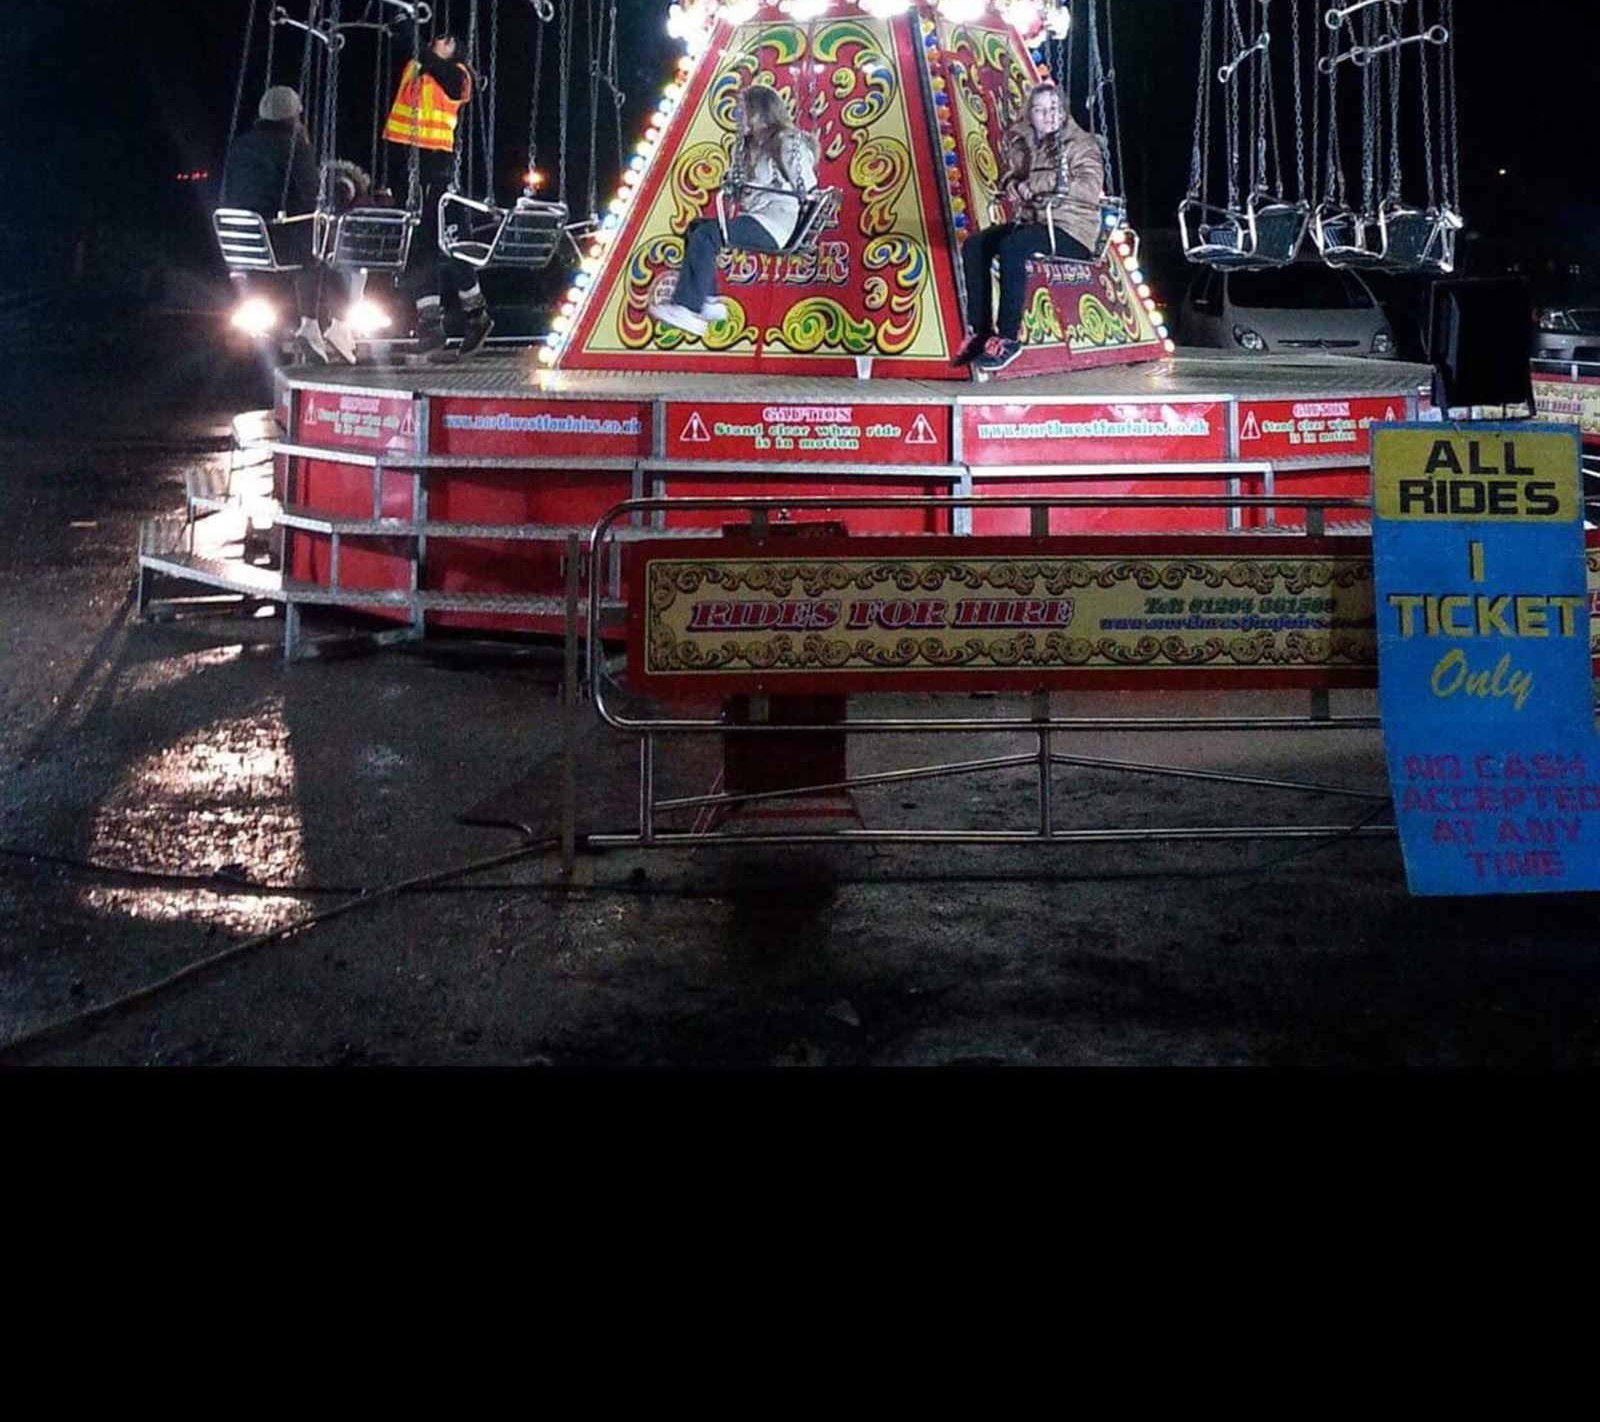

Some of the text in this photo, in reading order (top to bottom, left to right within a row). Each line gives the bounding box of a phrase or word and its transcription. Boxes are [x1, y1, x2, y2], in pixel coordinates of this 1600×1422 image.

[762, 407, 853, 423] CAUTION
[714, 423, 901, 438] Stand clear when ride
[755, 437, 860, 450] is in motion
[1424, 440, 1535, 476] ALL
[1399, 479, 1560, 516] RIDES
[688, 598, 1073, 631] RIDES FOR HIRE
[1386, 593, 1585, 638] TICKET
[1430, 649, 1533, 711] Only
[1405, 752, 1587, 781] NO CASH
[1403, 786, 1600, 814] ACCEPTED
[1432, 817, 1582, 846] AT ANY
[1467, 849, 1566, 878] TIME
